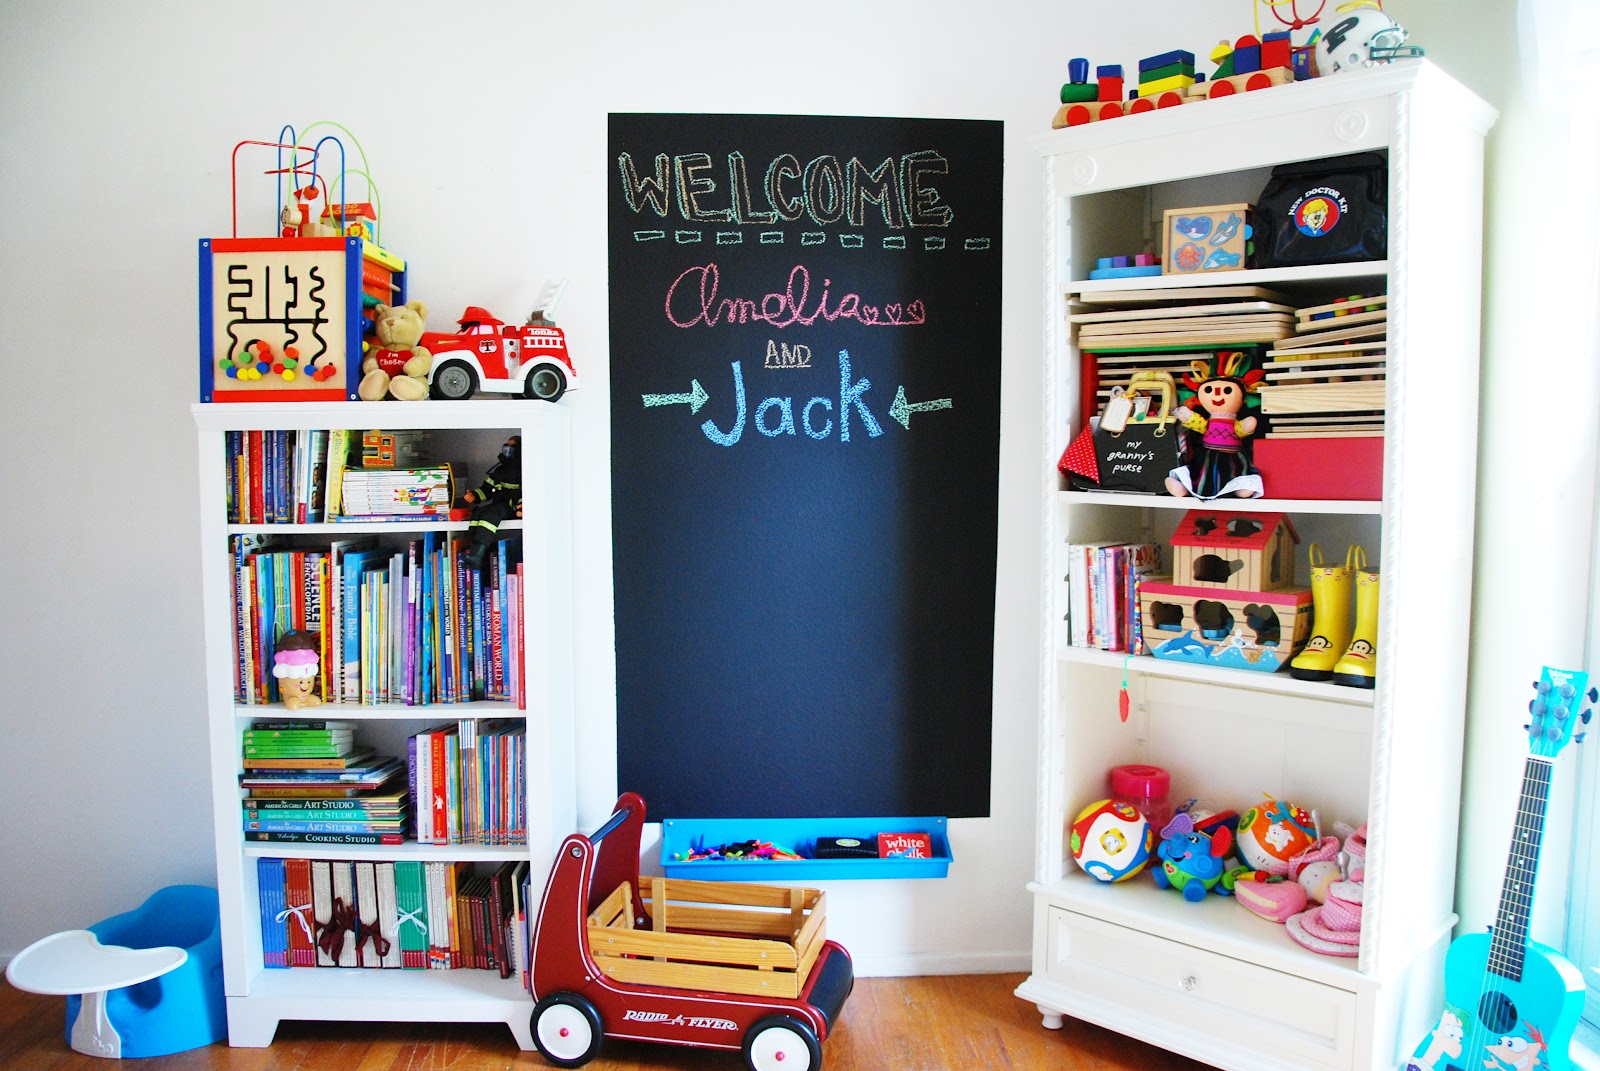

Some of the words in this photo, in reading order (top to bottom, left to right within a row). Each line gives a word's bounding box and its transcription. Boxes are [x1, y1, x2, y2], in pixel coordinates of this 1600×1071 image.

[1322, 16, 1360, 55] P
[618, 151, 953, 228] WELCOME
[1288, 197, 1303, 216] NEW
[1305, 187, 1340, 199] DOCTOR
[1337, 196, 1349, 214] KIT
[665, 263, 868, 329] Amelia
[527, 328, 559, 336] Tonka
[483, 341, 493, 352] T
[764, 339, 812, 366] AND
[701, 349, 884, 446] Jack
[1126, 440, 1143, 450] my
[311, 563, 321, 621] SCIENCE
[345, 585, 357, 614] Family
[473, 573, 481, 603] BEDTIME
[347, 617, 358, 640] Bible
[459, 612, 467, 648] Testament
[474, 604, 482, 630] STORIES
[493, 613, 502, 647] ROMAN
[495, 647, 503, 680] WORLD
[304, 801, 321, 809] ART
[322, 800, 354, 809] STUDIO
[306, 811, 323, 819] ART
[325, 811, 356, 819] STUDIO
[305, 833, 343, 843] COOKING
[345, 834, 376, 844] STUDIO
[306, 822, 323, 830] ART
[325, 822, 357, 831] STUDIO
[885, 836, 925, 848] white
[622, 1009, 669, 1020] RADIO
[688, 1017, 738, 1031] FLYER
